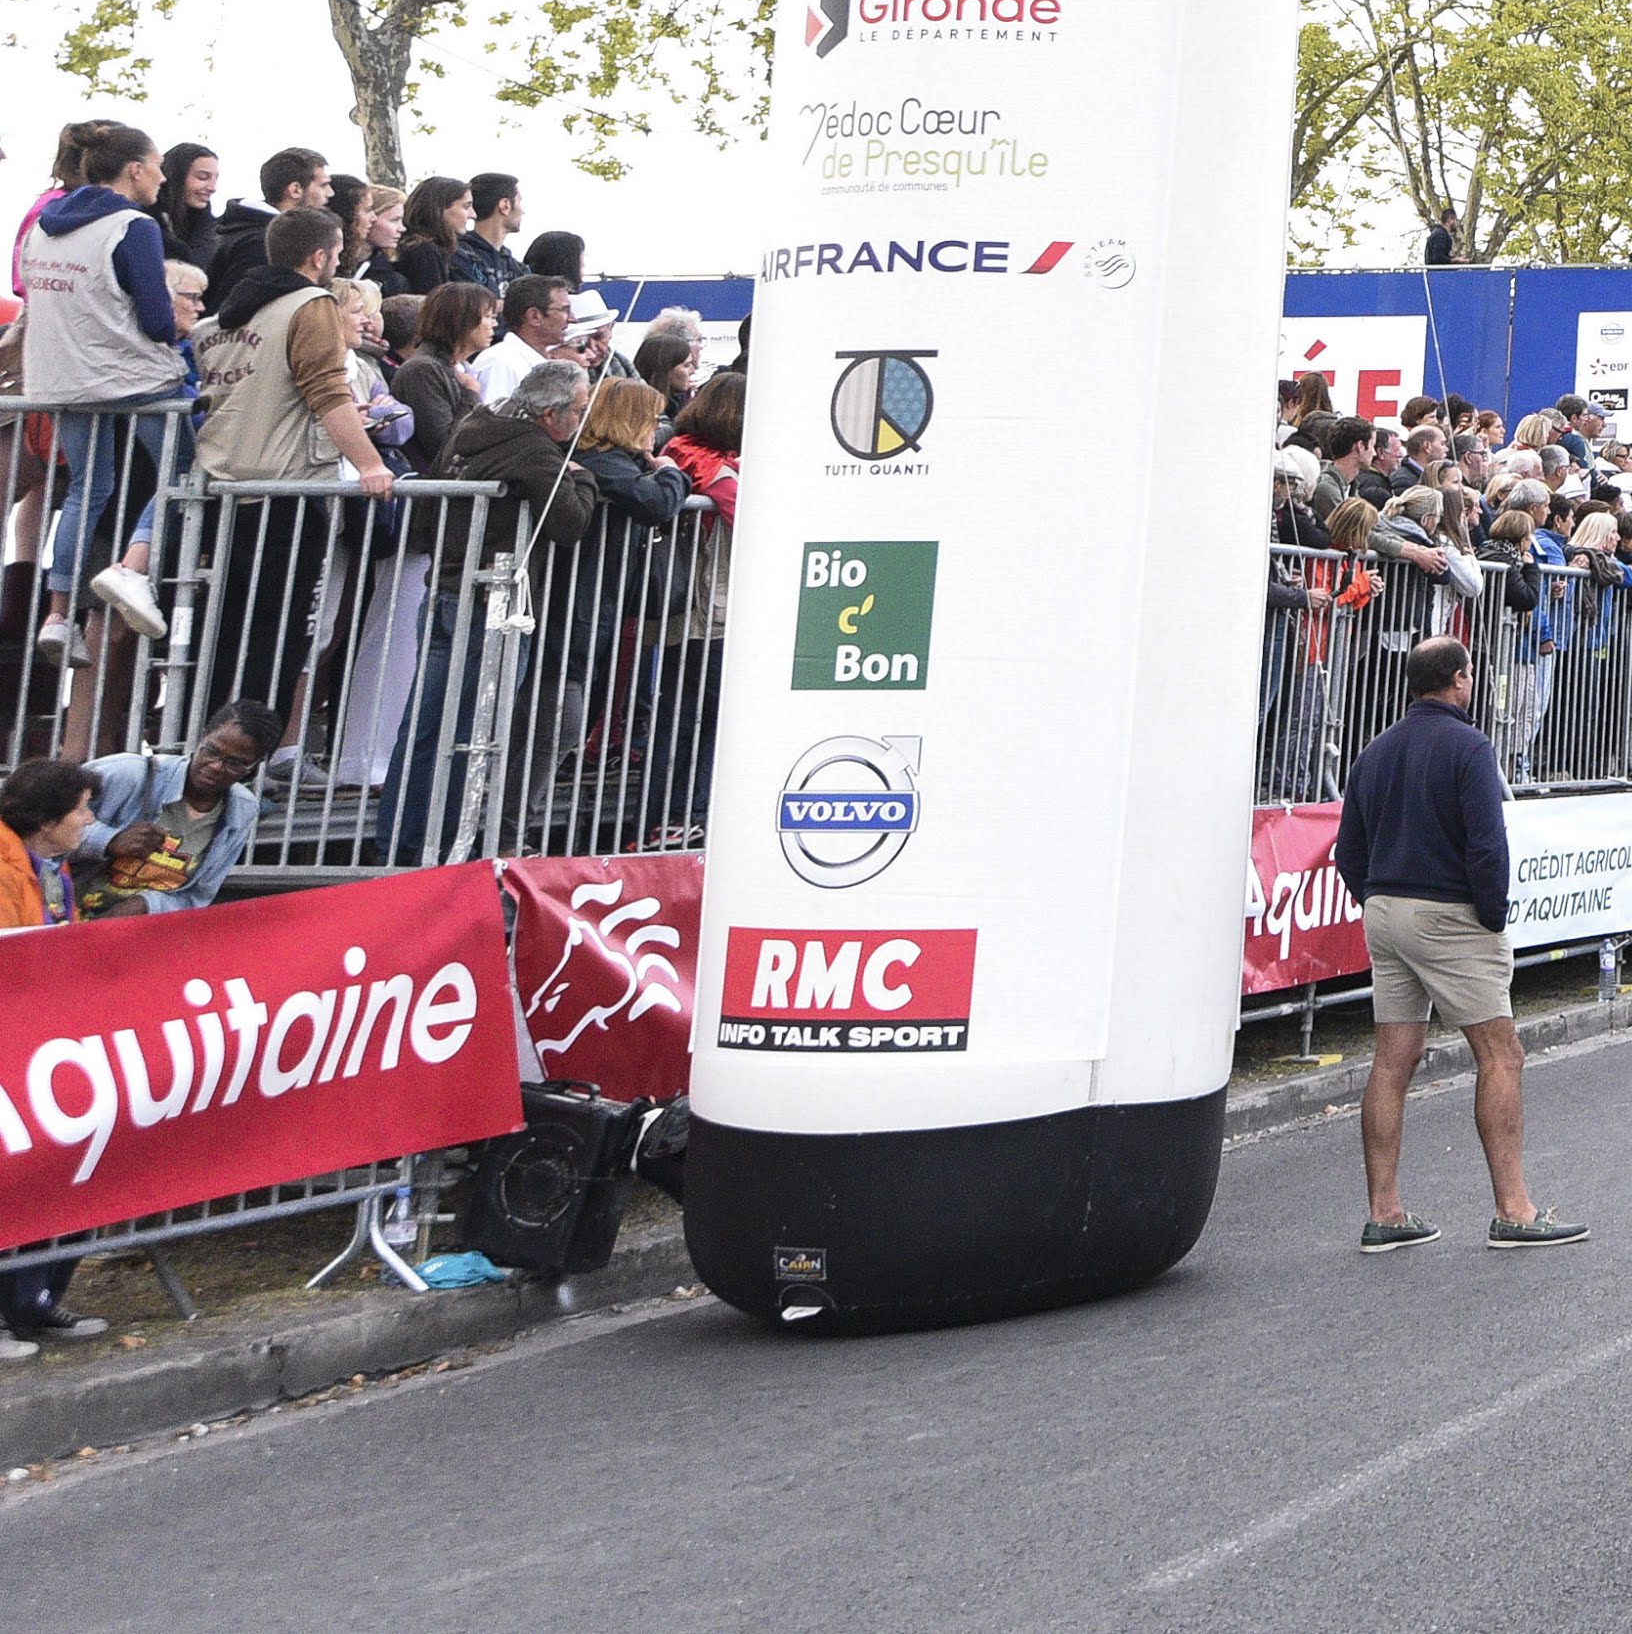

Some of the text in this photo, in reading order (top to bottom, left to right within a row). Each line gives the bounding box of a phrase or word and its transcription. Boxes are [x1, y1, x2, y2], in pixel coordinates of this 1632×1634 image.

[859, 27, 1059, 43] LE DÉPARTEMENT
[799, 97, 1001, 166] Médoc Cœur
[821, 137, 1050, 188] de Presqu'île
[879, 181, 890, 192] de
[893, 182, 949, 192] communes
[760, 239, 1010, 284] AIRFRANCE
[824, 463, 931, 477] TUTTI QUANTI
[805, 550, 868, 589] Bio
[834, 644, 920, 683] Bon
[785, 800, 907, 823] VOLVO
[1517, 849, 1574, 884] CRÉDIT
[750, 938, 923, 1011] RMC
[720, 1022, 966, 1048] INFO TALK SPORT
